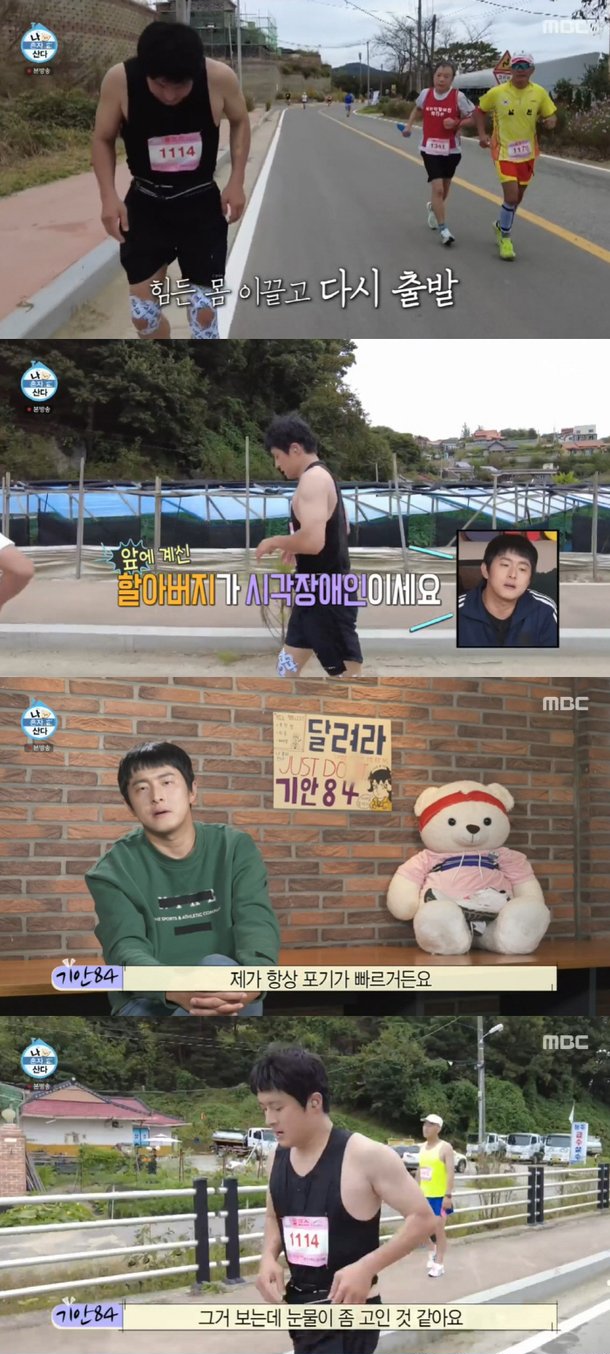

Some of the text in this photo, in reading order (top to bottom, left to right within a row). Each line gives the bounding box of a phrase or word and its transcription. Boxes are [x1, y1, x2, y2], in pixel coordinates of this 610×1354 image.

[159, 145, 196, 159] 1114
[308, 718, 387, 756] 달려라
[279, 755, 320, 777] JUST
[322, 758, 347, 779] DO
[289, 1232, 320, 1249] 1114
